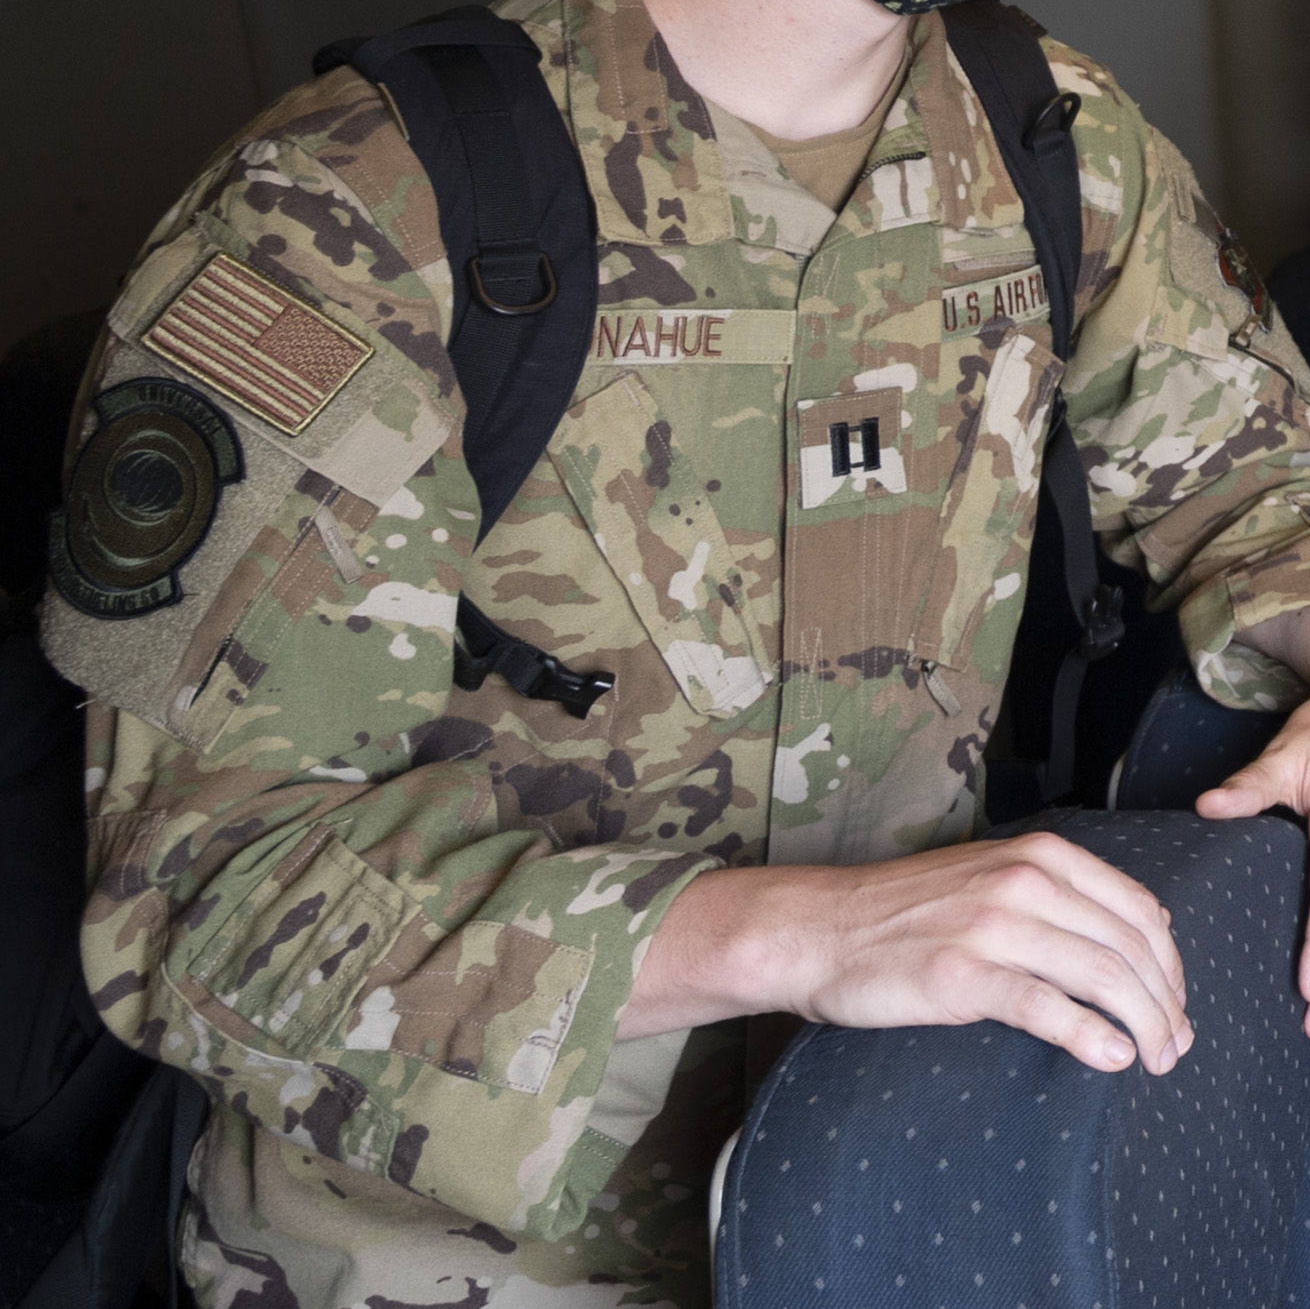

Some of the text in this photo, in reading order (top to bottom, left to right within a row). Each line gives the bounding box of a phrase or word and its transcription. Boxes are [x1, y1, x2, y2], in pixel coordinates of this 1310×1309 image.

[942, 291, 989, 332] U.S.
[993, 278, 1028, 320] AIR
[588, 316, 726, 358] NAHUE
